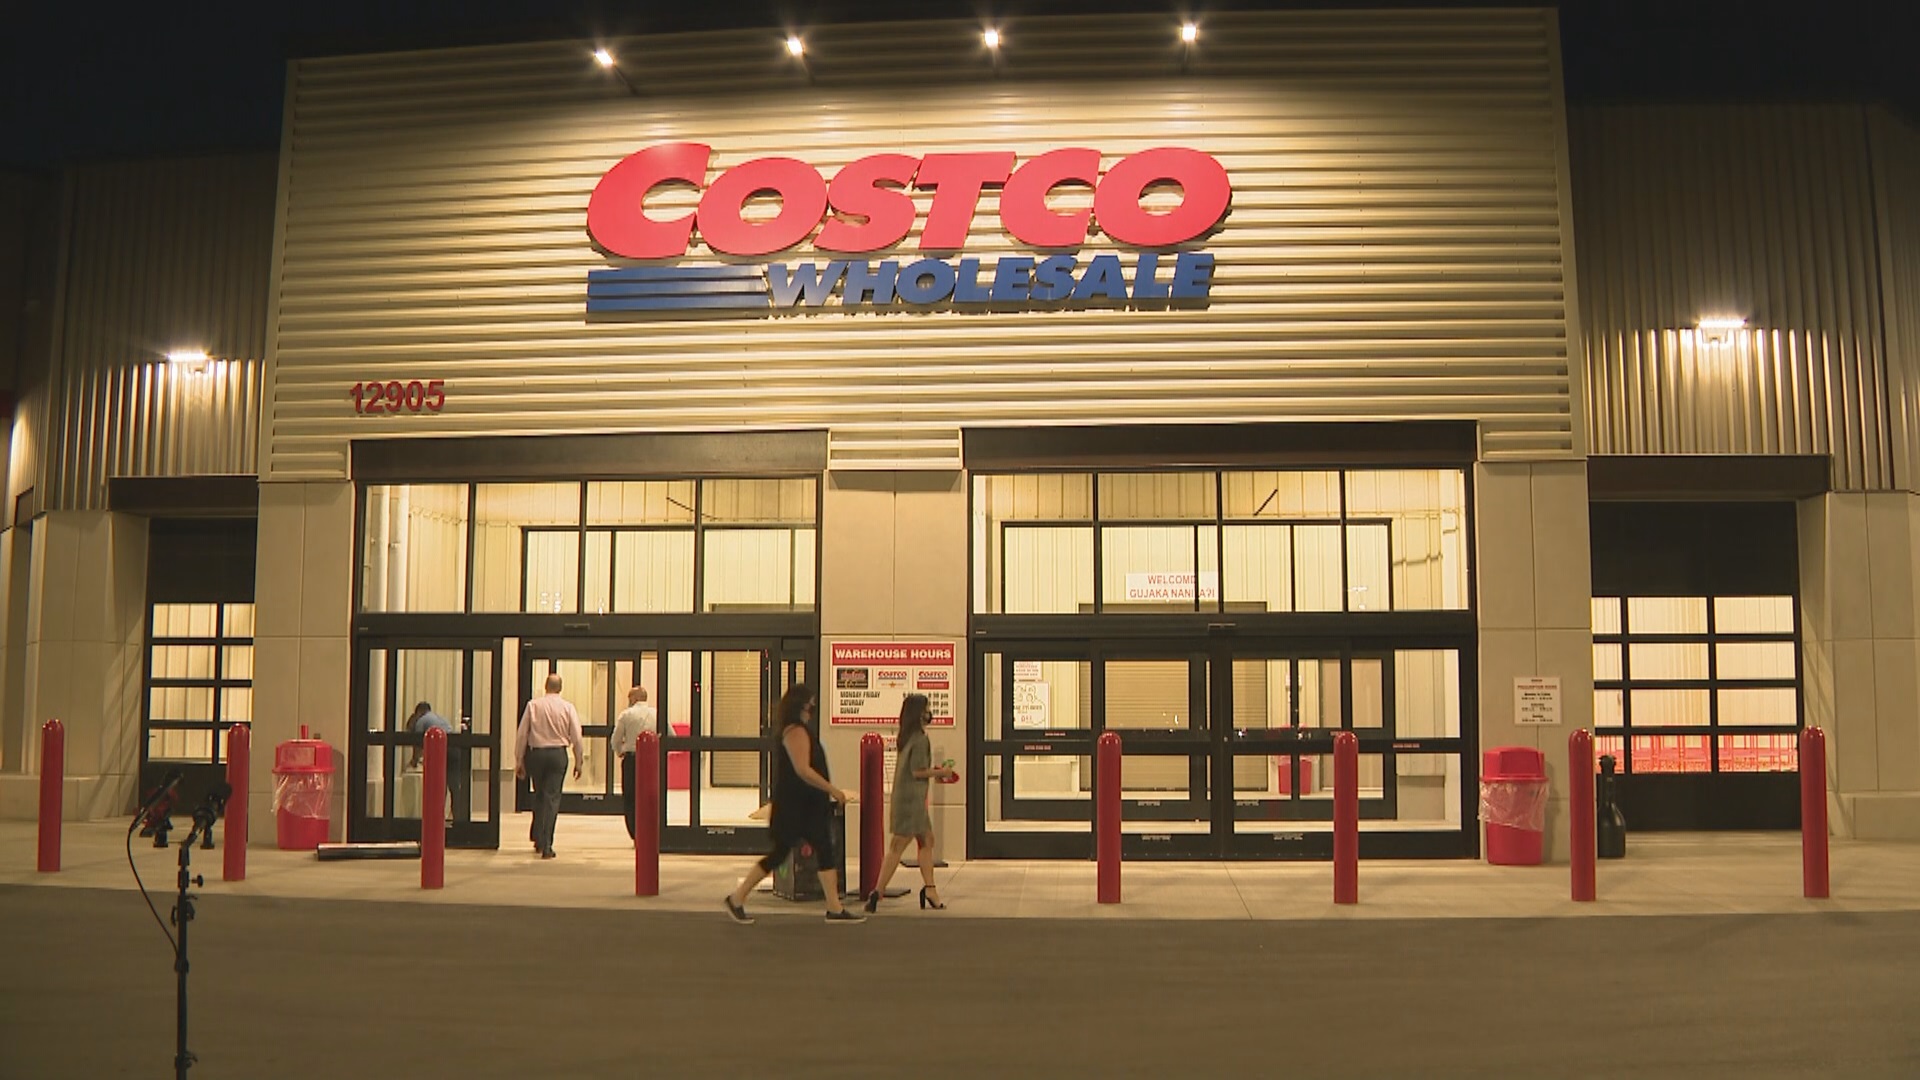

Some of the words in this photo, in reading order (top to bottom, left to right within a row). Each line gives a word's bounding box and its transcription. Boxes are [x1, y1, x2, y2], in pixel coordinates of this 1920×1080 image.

[586, 142, 1231, 259] COSTCO
[768, 253, 1215, 309] WHOLESALE
[350, 380, 445, 414] 12905
[1129, 588, 1169, 598] GUJAKA
[835, 649, 908, 659] WAREHOUSE
[911, 649, 951, 659] HOURS
